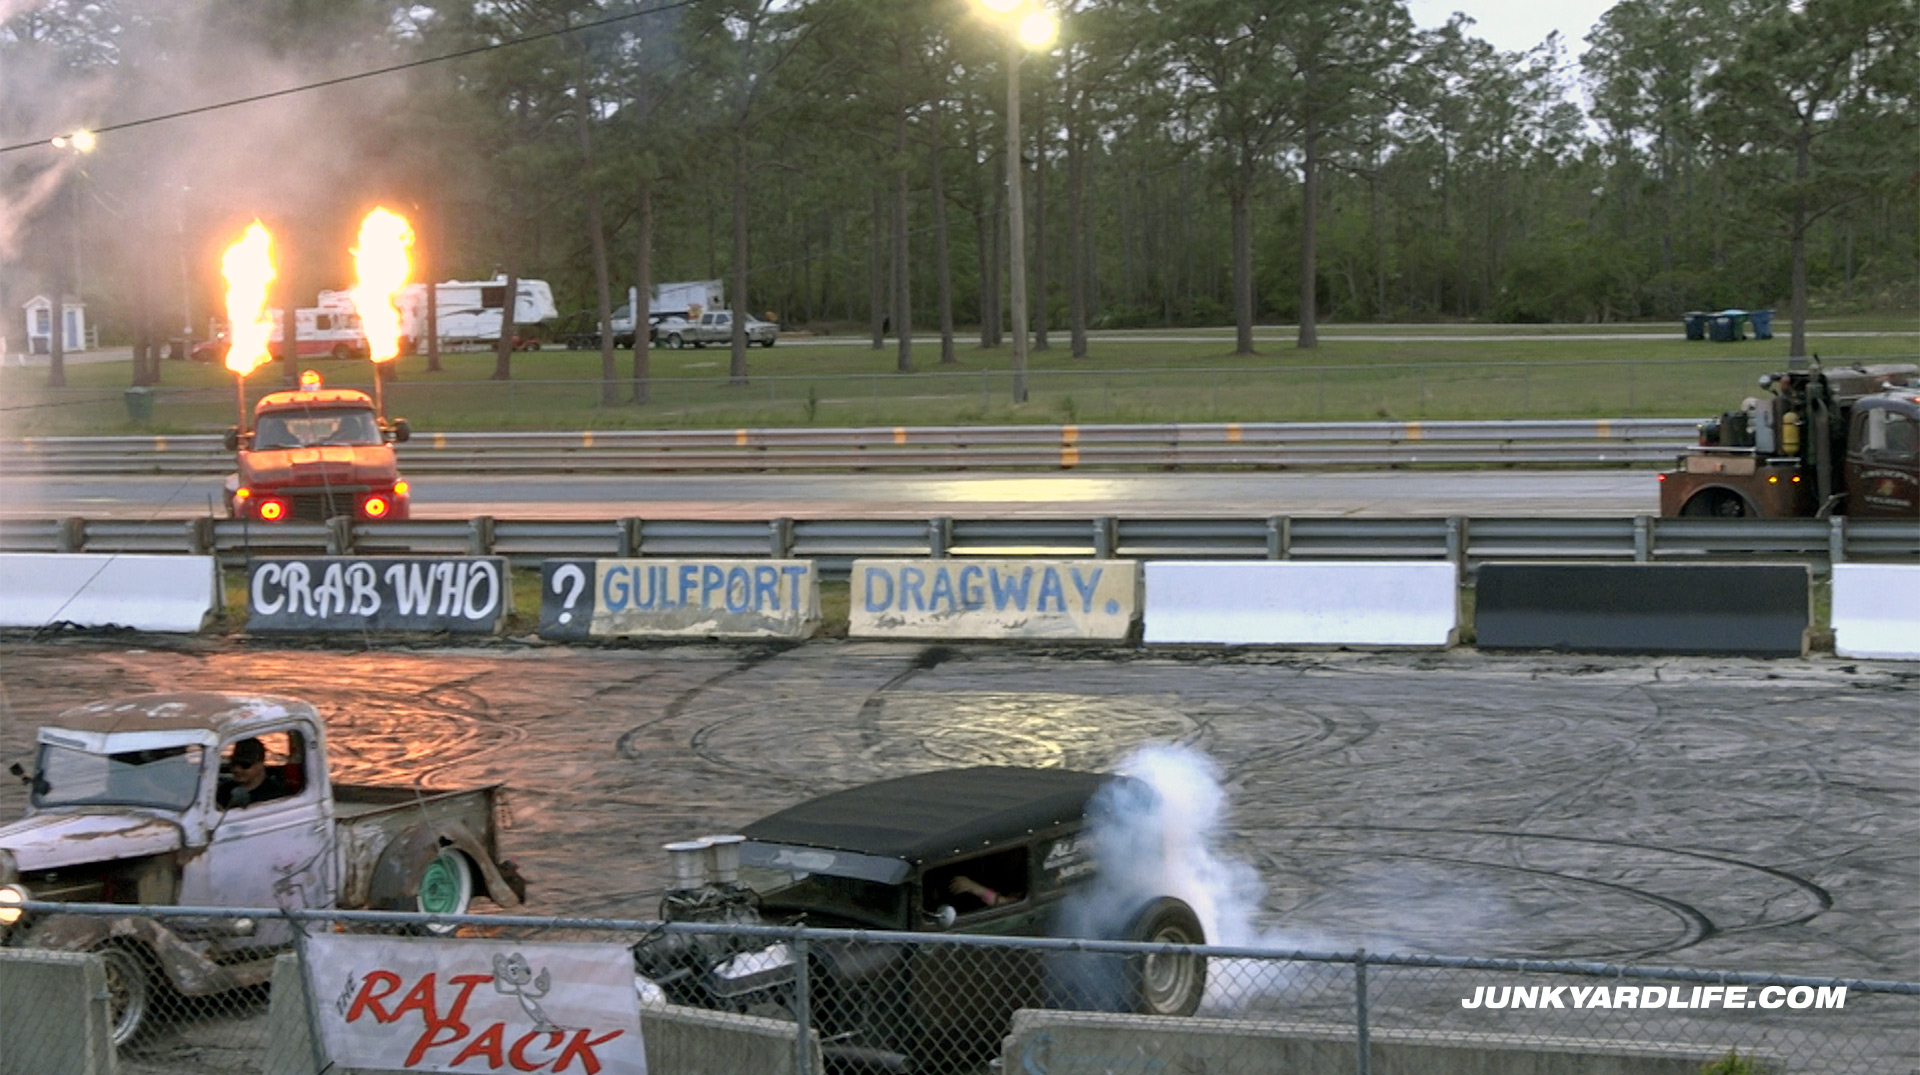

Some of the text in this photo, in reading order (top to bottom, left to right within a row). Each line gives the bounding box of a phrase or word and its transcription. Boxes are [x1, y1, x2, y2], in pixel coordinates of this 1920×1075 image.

[252, 560, 586, 625] CRAB WHO ?
[602, 564, 1121, 615] GULFPORT DRAGWAY.
[346, 970, 495, 1024] RAT
[404, 1020, 625, 1075] PACK
